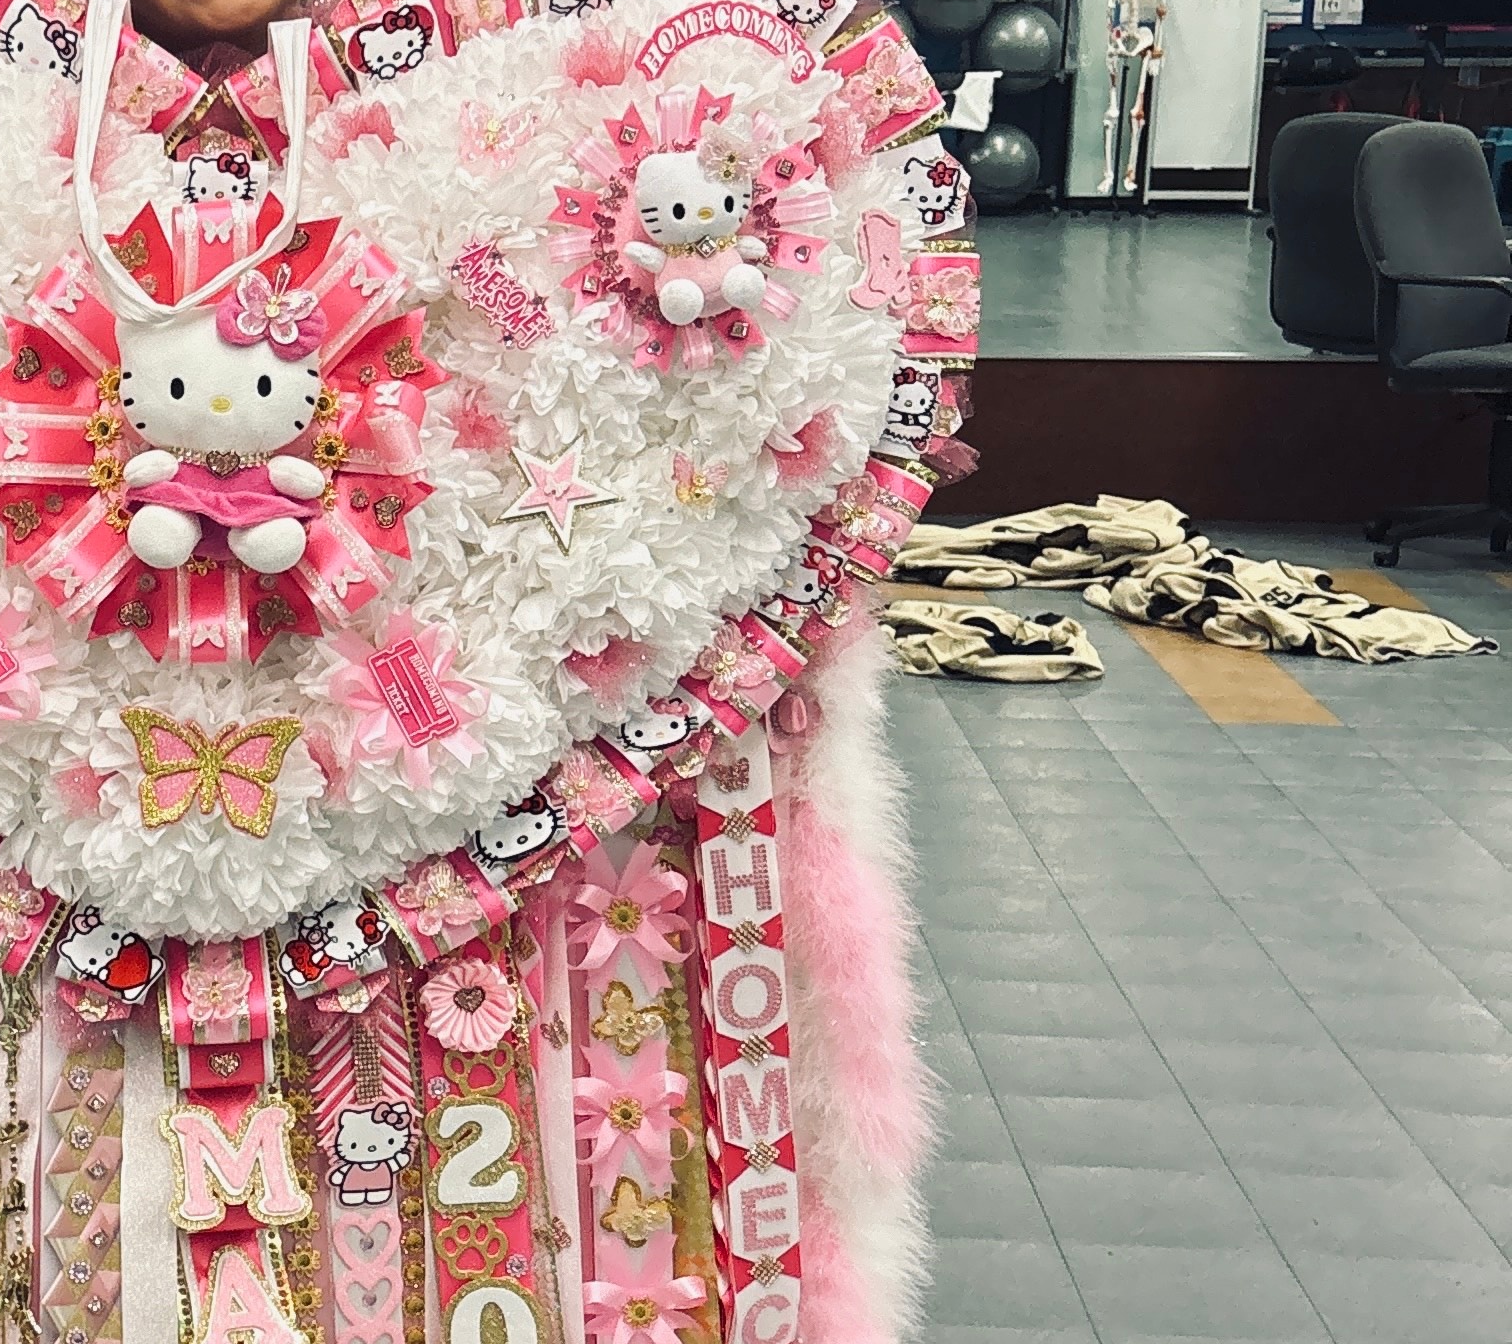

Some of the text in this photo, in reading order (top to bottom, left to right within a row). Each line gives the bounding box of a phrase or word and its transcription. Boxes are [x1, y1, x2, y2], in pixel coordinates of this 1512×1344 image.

[639, 3, 814, 81] HOMECOMING
[457, 239, 550, 349] AWESOME!
[386, 682, 409, 716] TICKET
